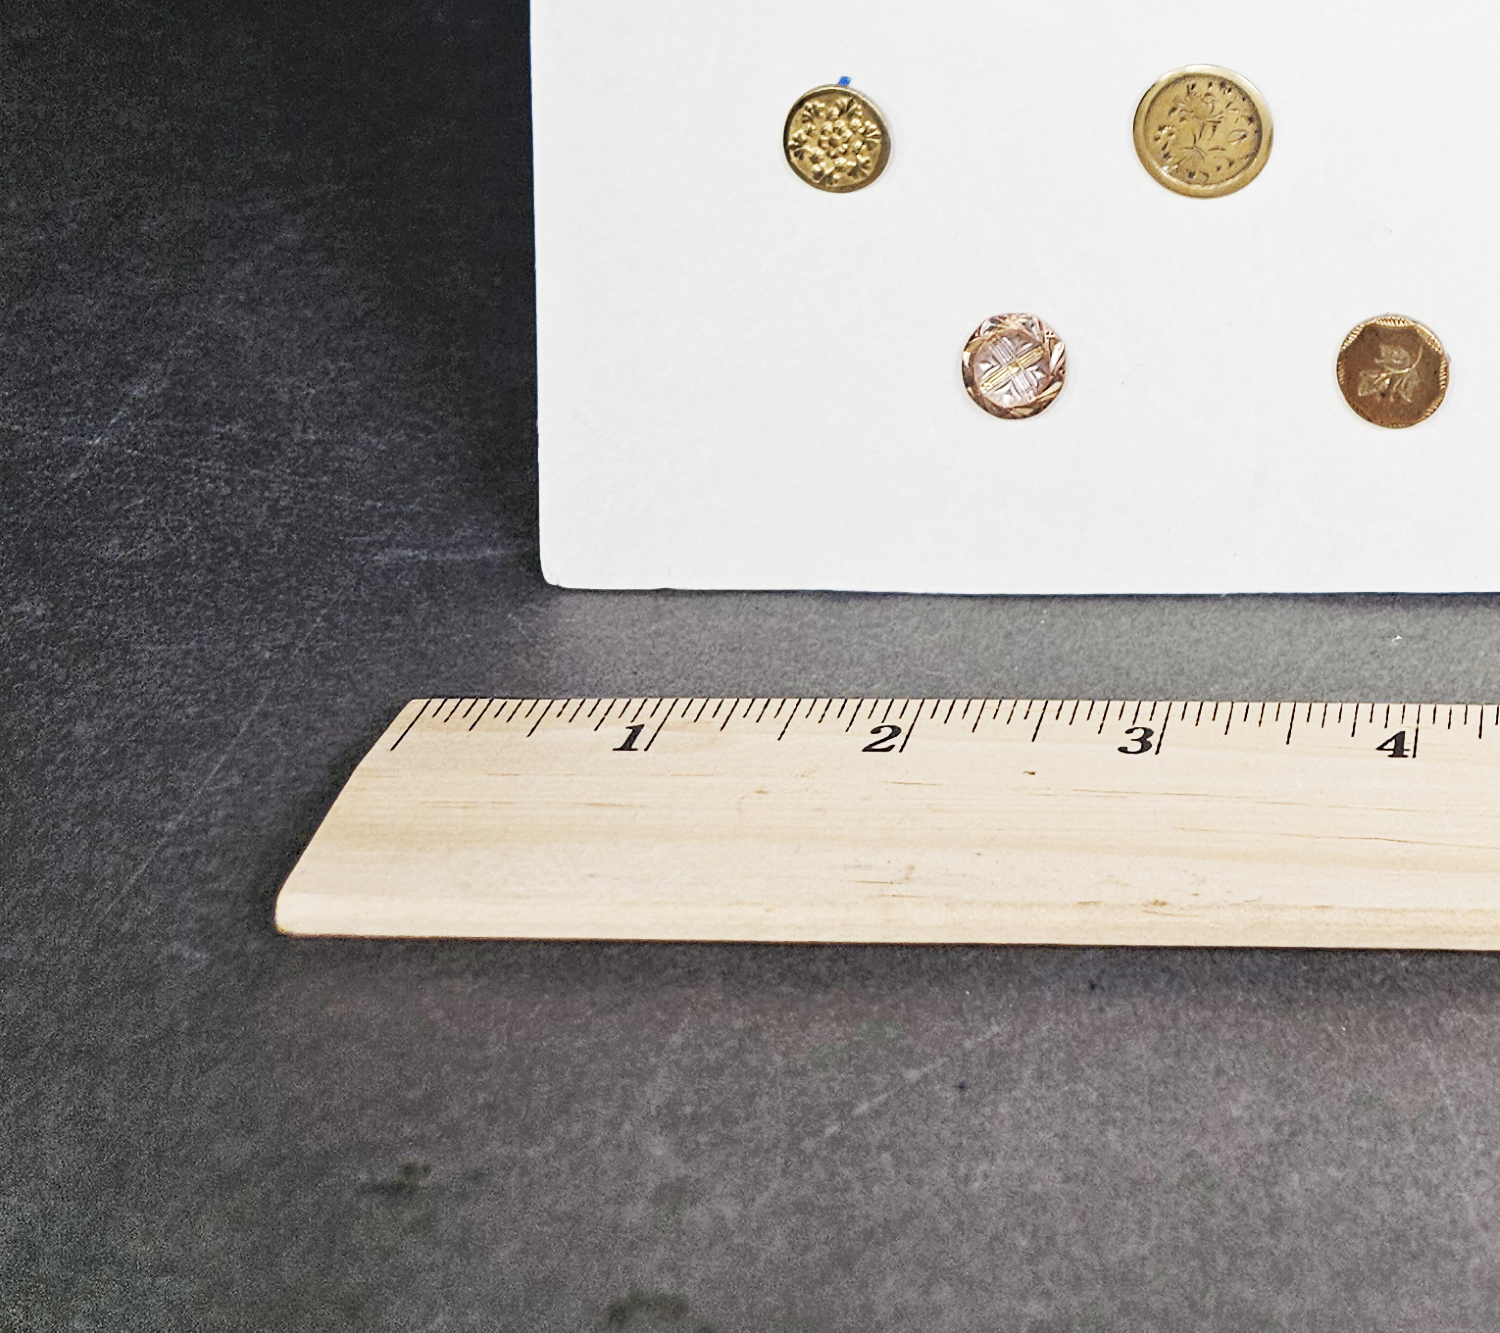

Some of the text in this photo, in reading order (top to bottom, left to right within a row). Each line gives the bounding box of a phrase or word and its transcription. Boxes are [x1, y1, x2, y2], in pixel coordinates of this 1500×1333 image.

[612, 724, 648, 752] 1
[860, 721, 904, 756] 2
[1115, 725, 1158, 758] 3
[1374, 730, 1411, 759] 4
